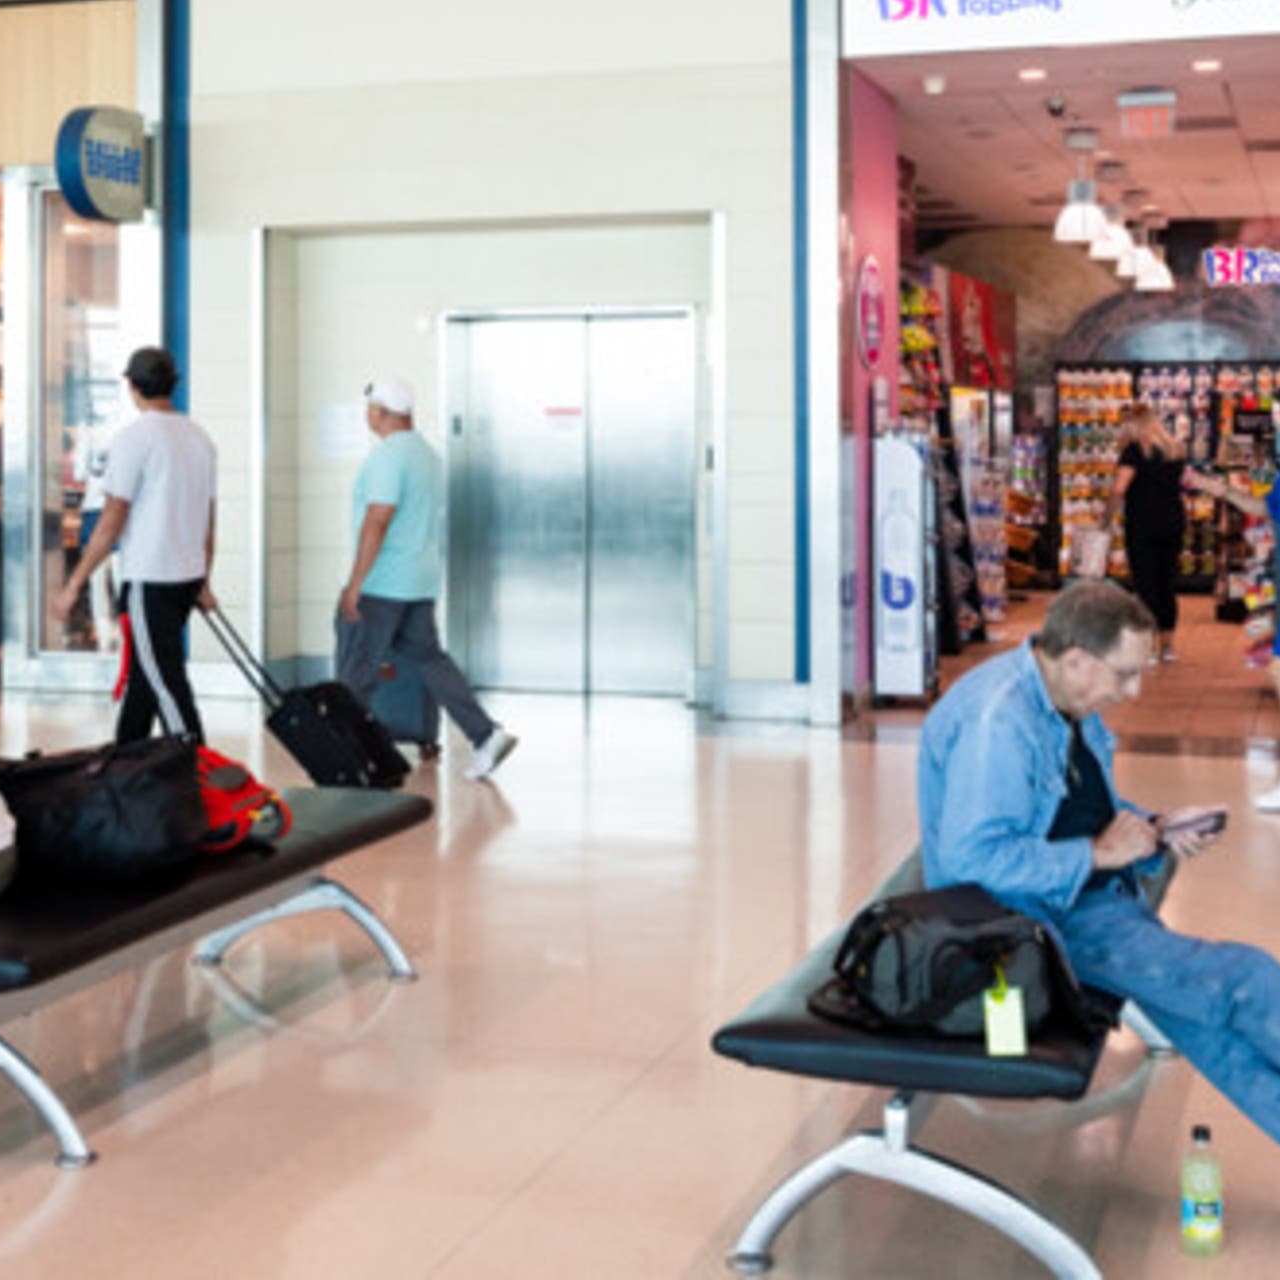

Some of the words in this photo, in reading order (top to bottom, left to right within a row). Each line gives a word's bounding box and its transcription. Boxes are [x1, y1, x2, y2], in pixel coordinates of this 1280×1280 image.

[84, 139, 143, 166] DALLAS
[87, 158, 142, 187] SPORTS
[1205, 249, 1259, 287] BR
